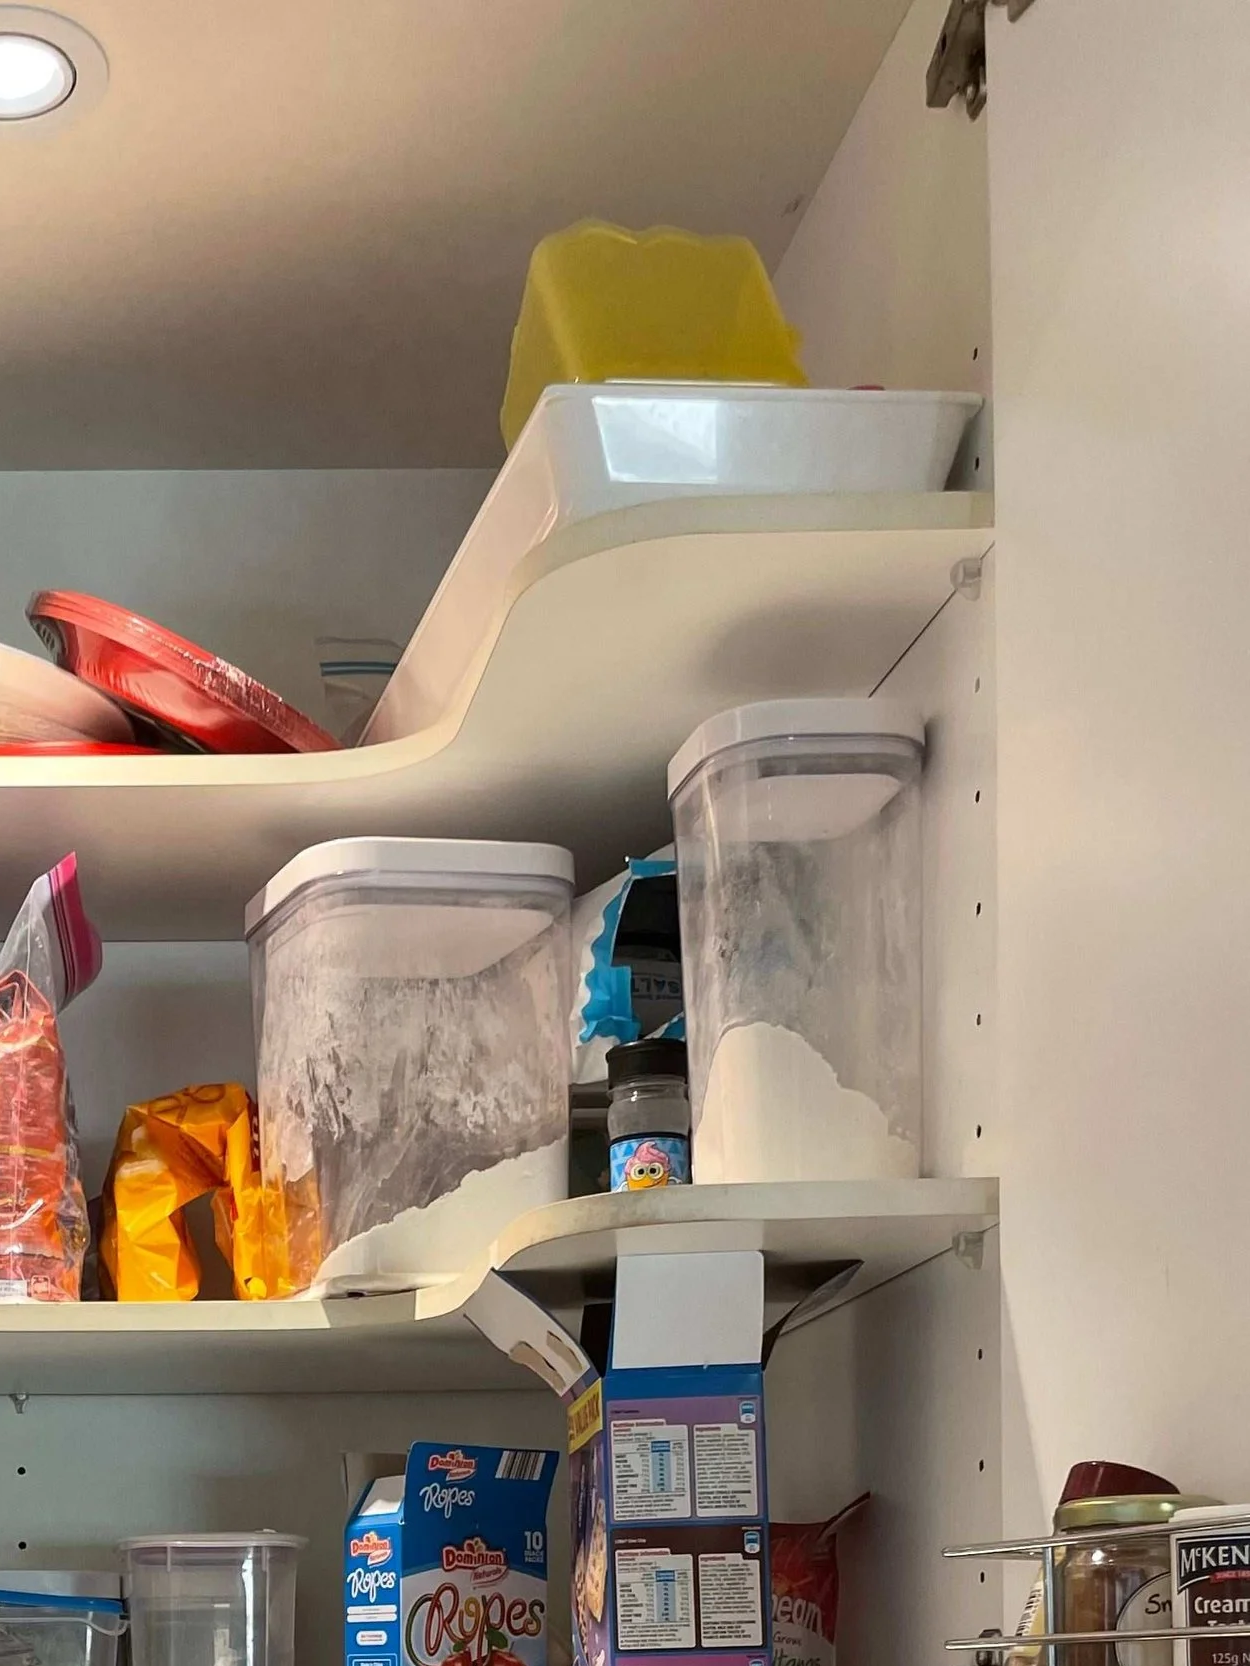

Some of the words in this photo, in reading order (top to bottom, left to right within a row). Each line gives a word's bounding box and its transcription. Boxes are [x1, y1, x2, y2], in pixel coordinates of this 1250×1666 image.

[429, 1454, 476, 1470] Dominion
[419, 1482, 475, 1519] Ropes
[351, 1538, 390, 1557] Dominion
[524, 1531, 543, 1550] 10
[443, 1546, 505, 1571] Dominion
[1180, 1544, 1250, 1577] McKEN
[347, 1568, 396, 1603] Ropes
[1212, 1653, 1238, 1666] 125g
